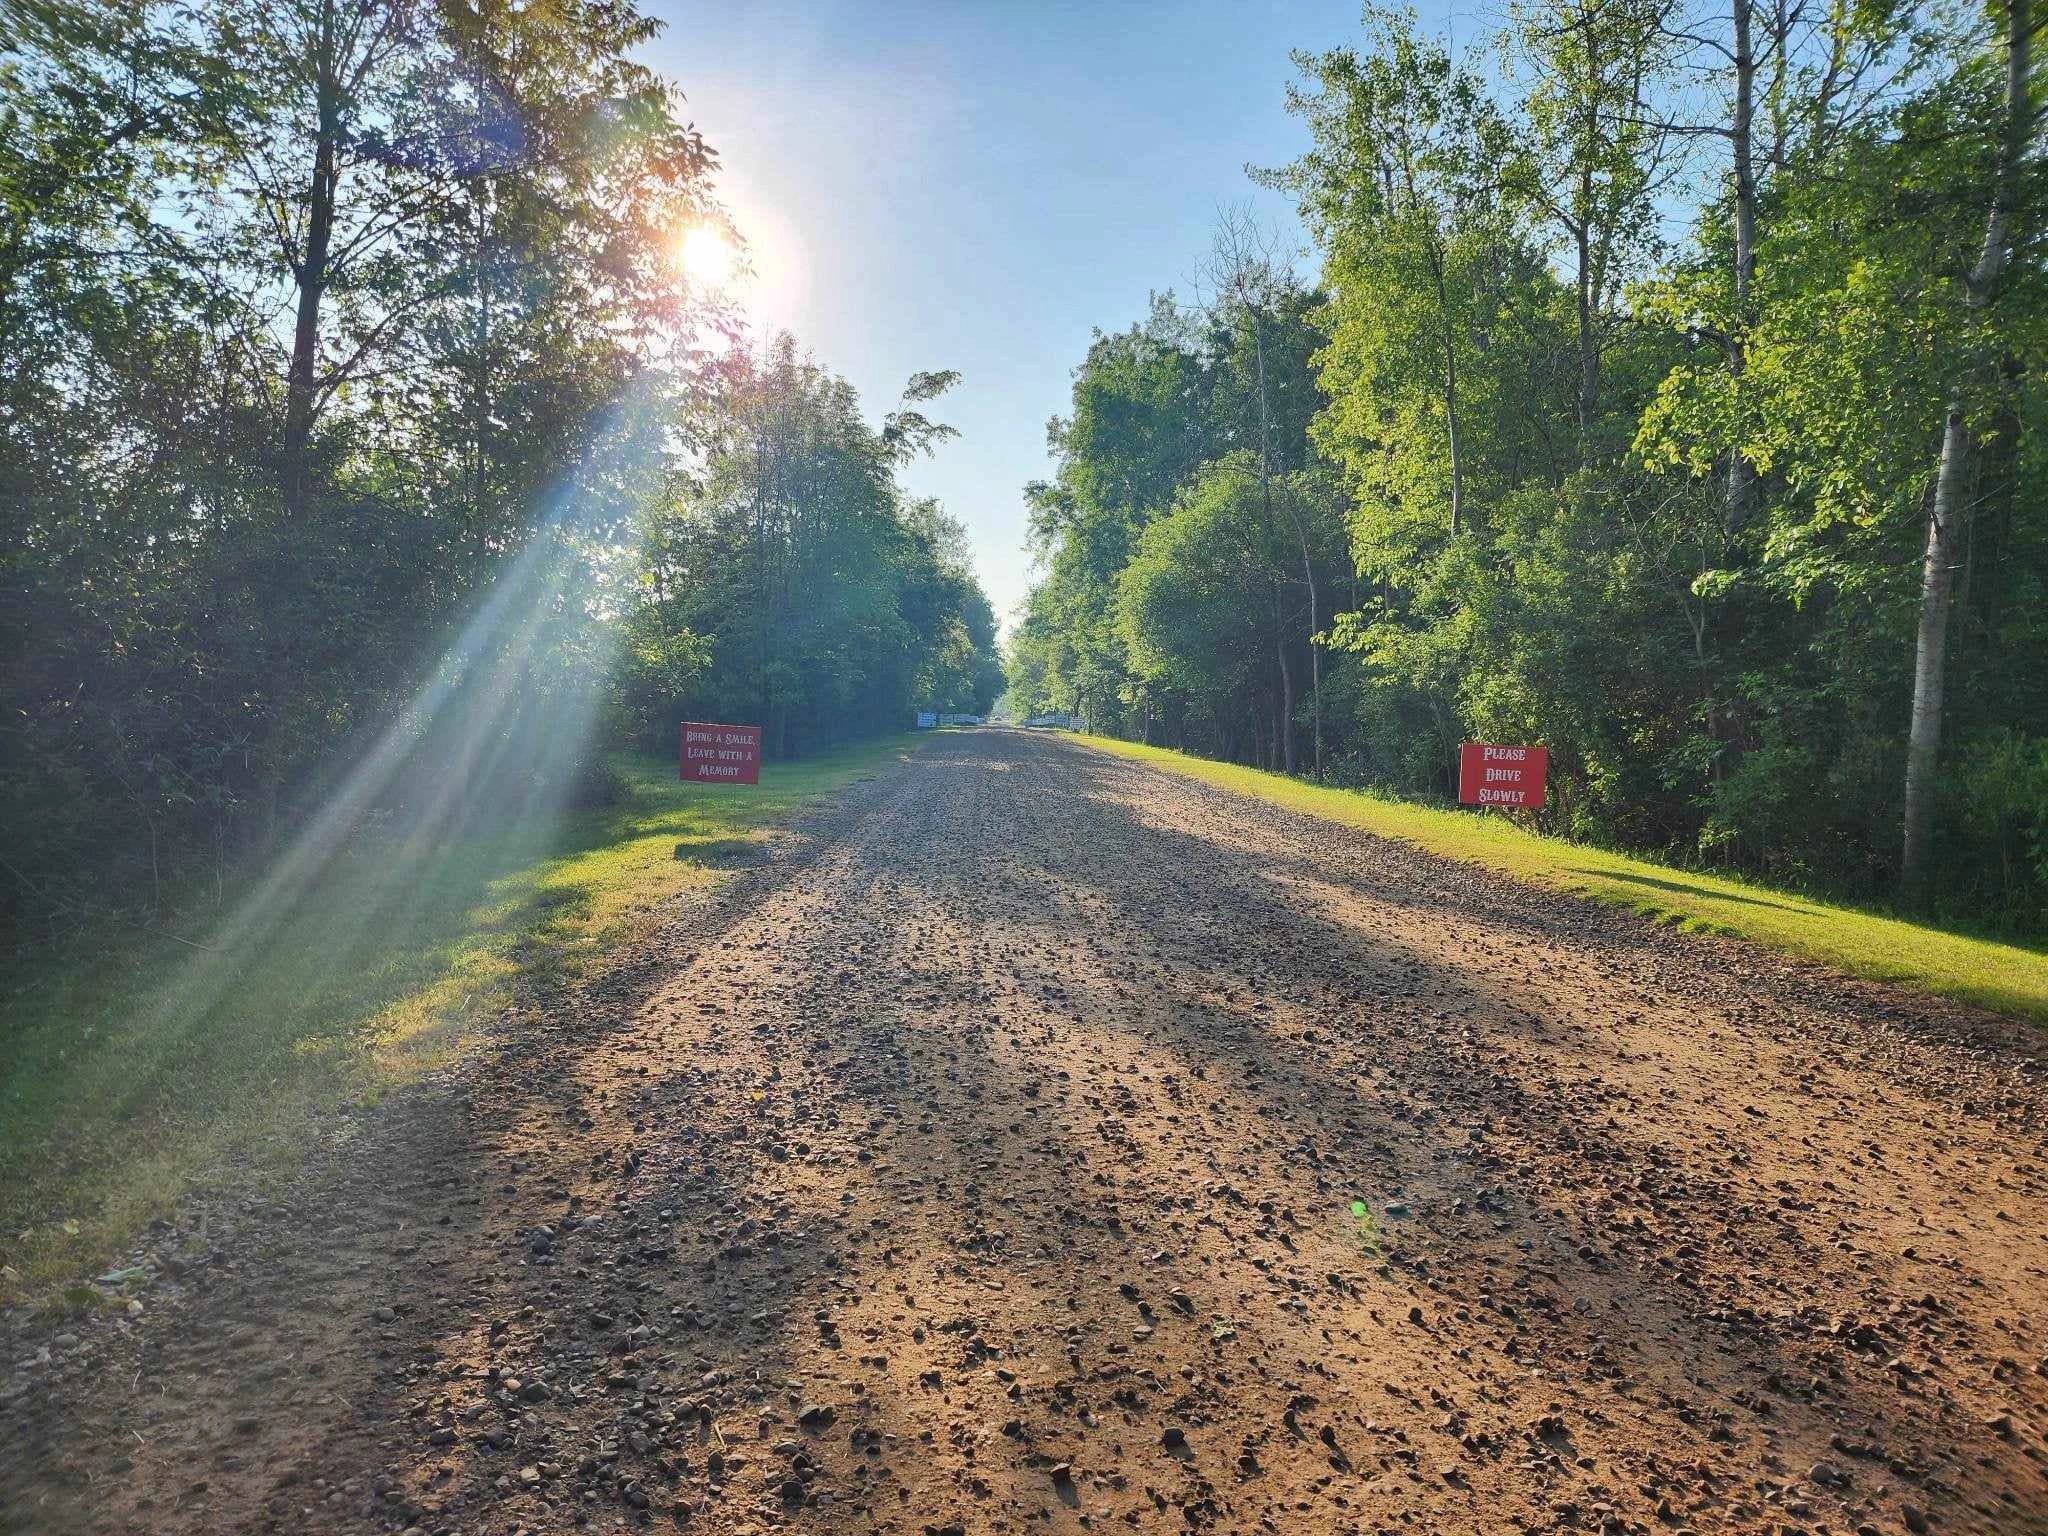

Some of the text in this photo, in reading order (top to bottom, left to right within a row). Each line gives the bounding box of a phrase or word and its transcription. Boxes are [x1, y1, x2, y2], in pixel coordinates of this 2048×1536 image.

[687, 731, 712, 742] BRING
[715, 734, 721, 743] A
[687, 747, 752, 761] LEAVE WITH A
[1483, 747, 1526, 761] PLEASE
[698, 765, 739, 776] MEMORY
[1485, 768, 1521, 782] DRIVE
[1479, 789, 1525, 803] SLOWLY
